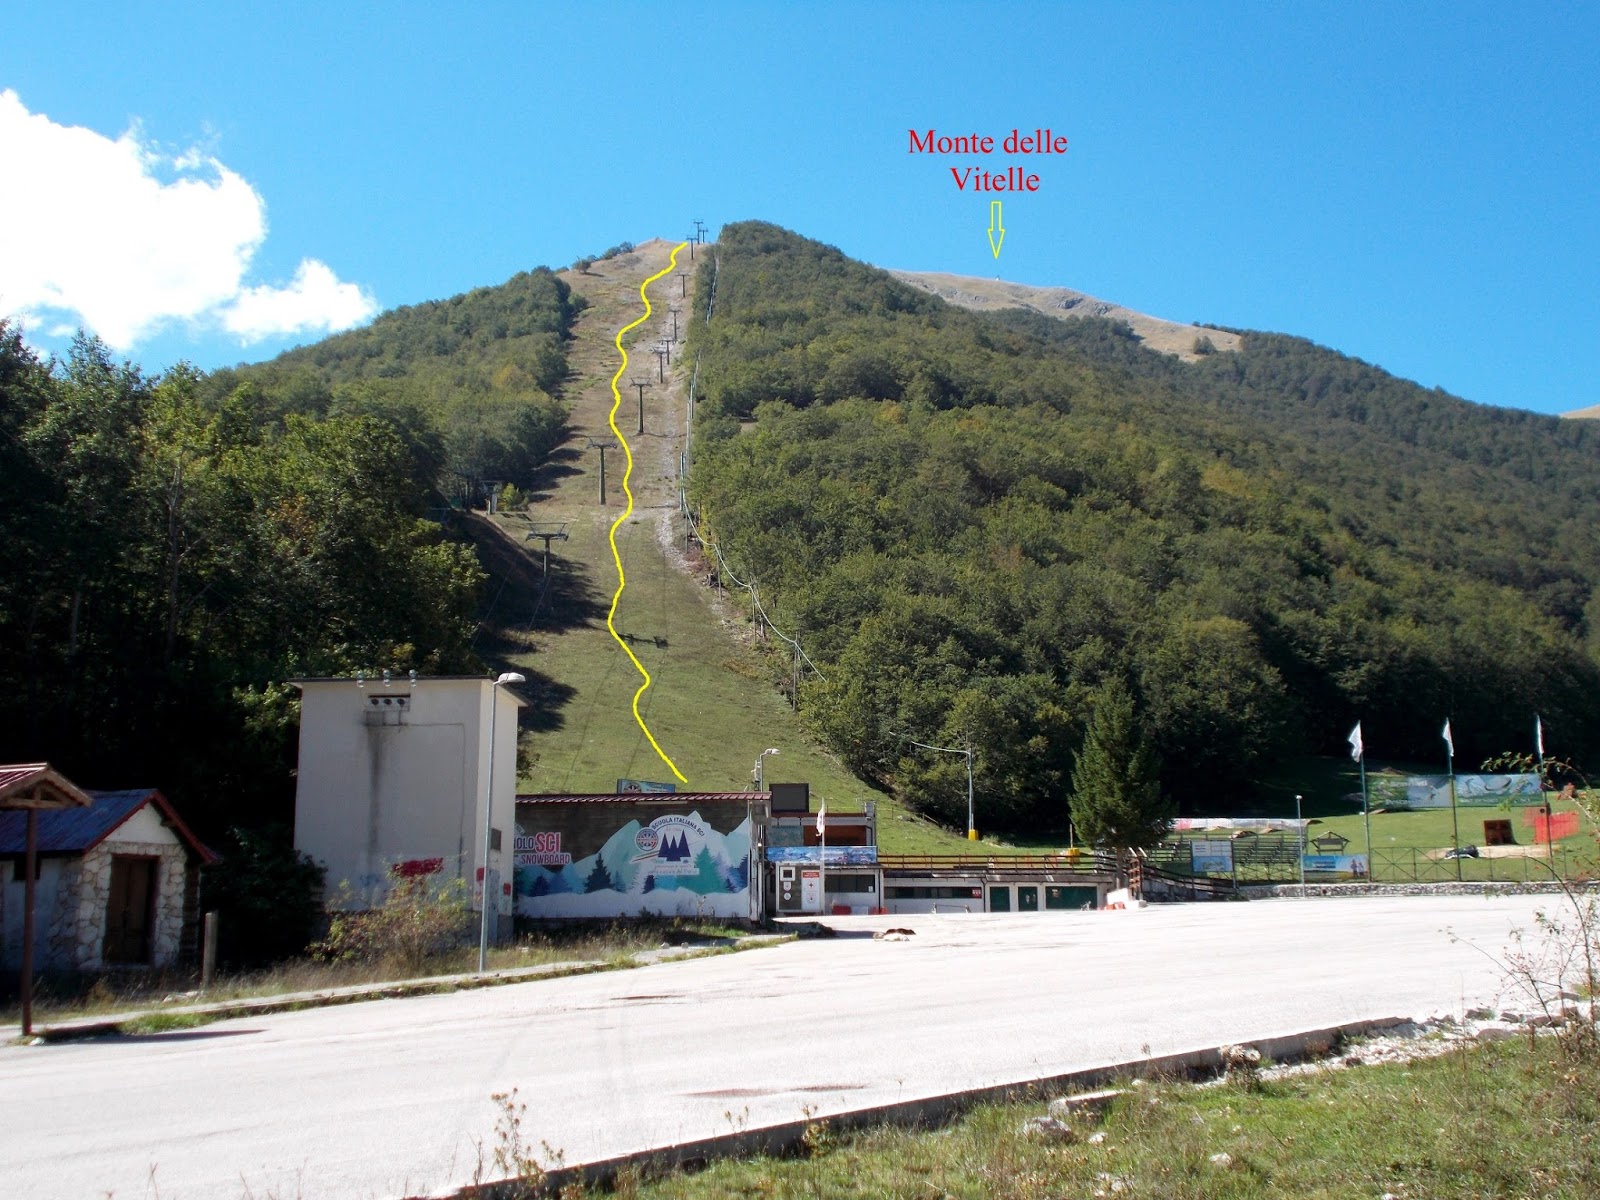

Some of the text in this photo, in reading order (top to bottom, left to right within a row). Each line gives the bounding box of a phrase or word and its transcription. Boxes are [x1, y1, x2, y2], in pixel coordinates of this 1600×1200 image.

[652, 817, 673, 829] SCUOLA
[673, 817, 697, 829] ITALIANA
[696, 826, 705, 837] SCI
[536, 832, 560, 852] SCI
[521, 854, 570, 865] SNOWBOARD
